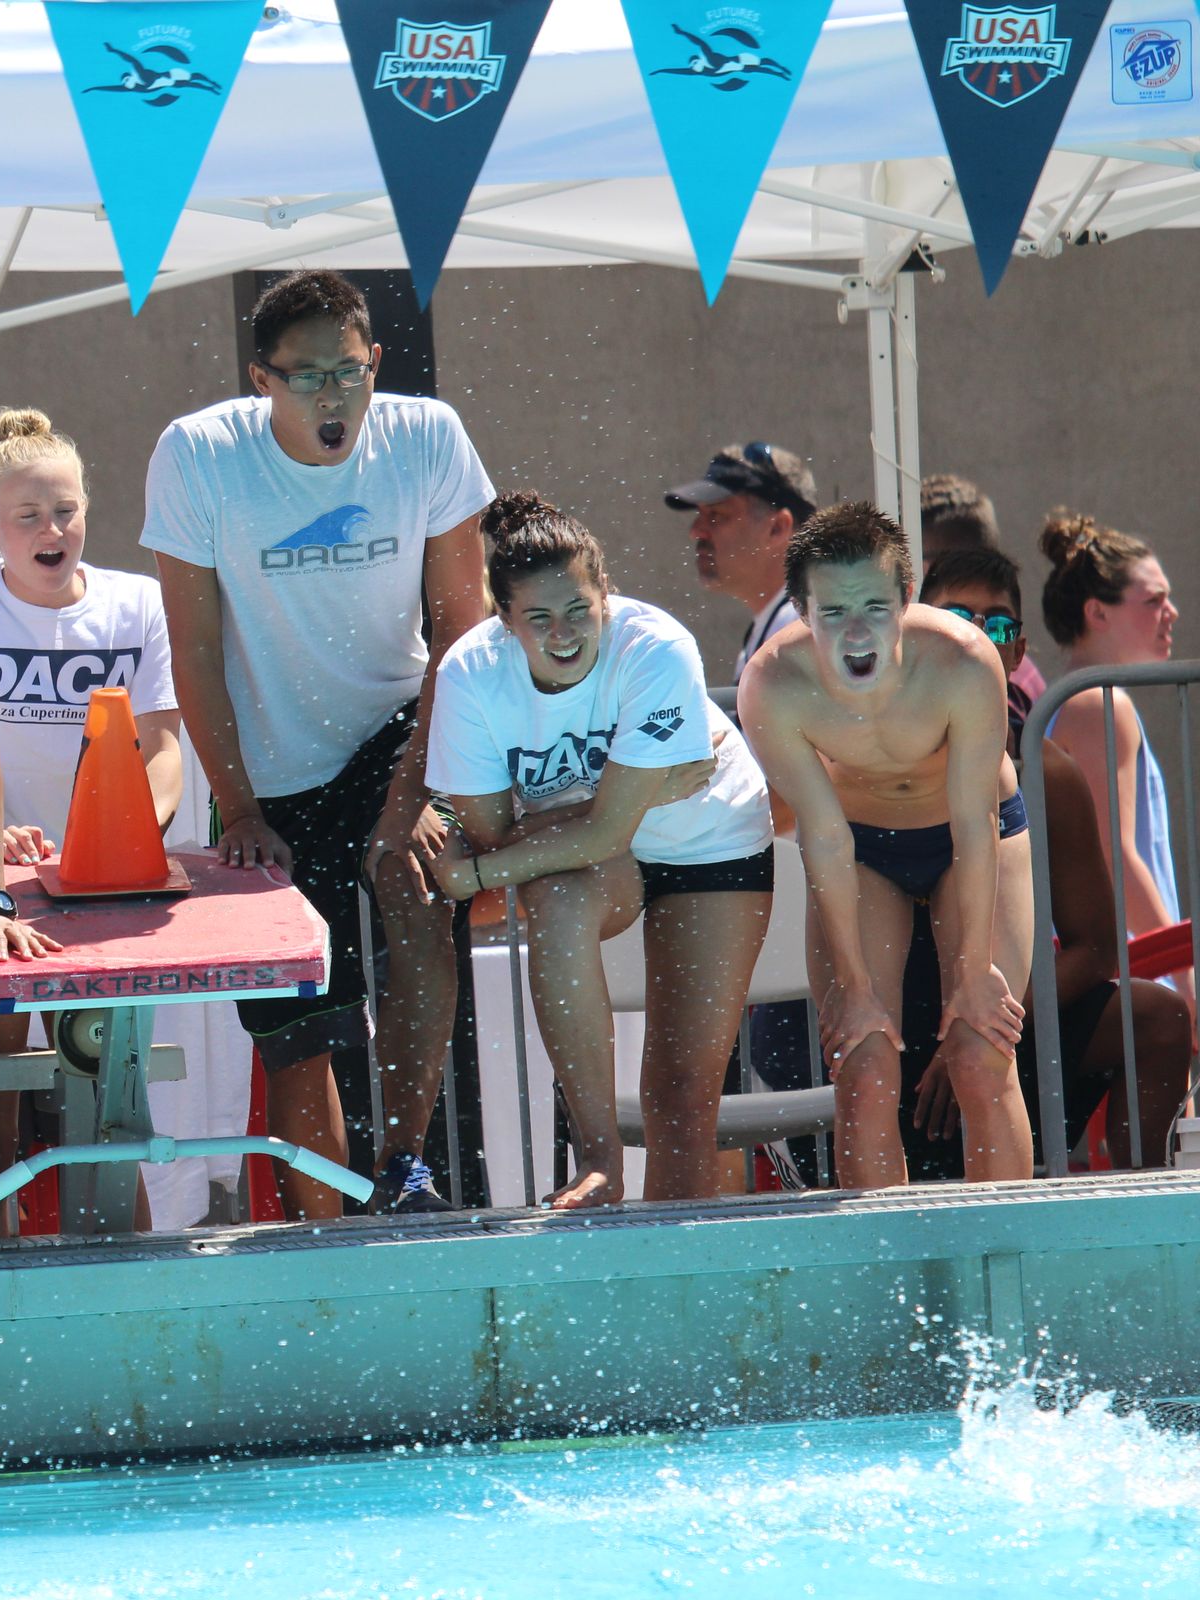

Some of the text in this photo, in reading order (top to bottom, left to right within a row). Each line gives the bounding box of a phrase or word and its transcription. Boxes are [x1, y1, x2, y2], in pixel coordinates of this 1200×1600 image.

[974, 17, 1040, 44] USA
[408, 33, 474, 60] USA
[955, 46, 1057, 61] SWIMMING
[389, 61, 492, 77] SWIMMING
[261, 536, 399, 569] DACA
[19, 706, 86, 720] Cupertino
[647, 706, 682, 722] arena
[32, 966, 275, 1000] DAKTRONICS
